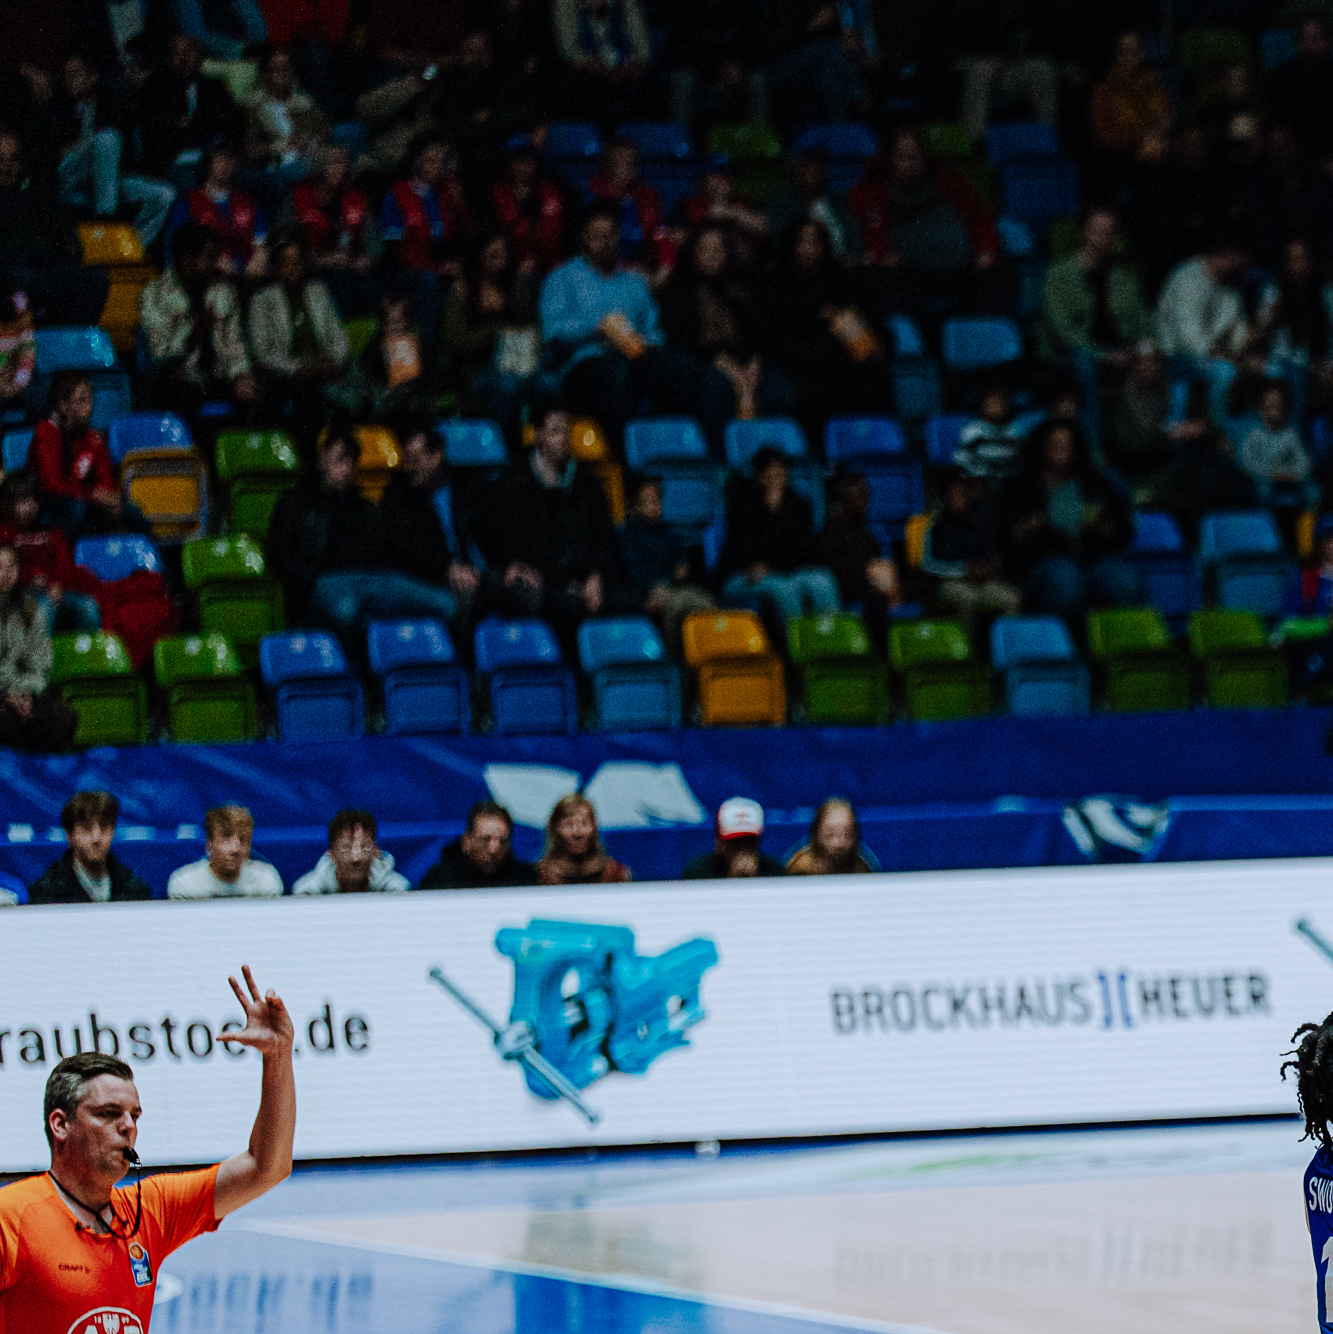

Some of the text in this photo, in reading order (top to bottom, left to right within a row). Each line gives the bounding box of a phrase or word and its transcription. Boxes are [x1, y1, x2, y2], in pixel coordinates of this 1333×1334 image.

[0, 1000, 372, 1064] raubstoc.de
[831, 970, 1272, 1034] BROCKHAUS HEUER
